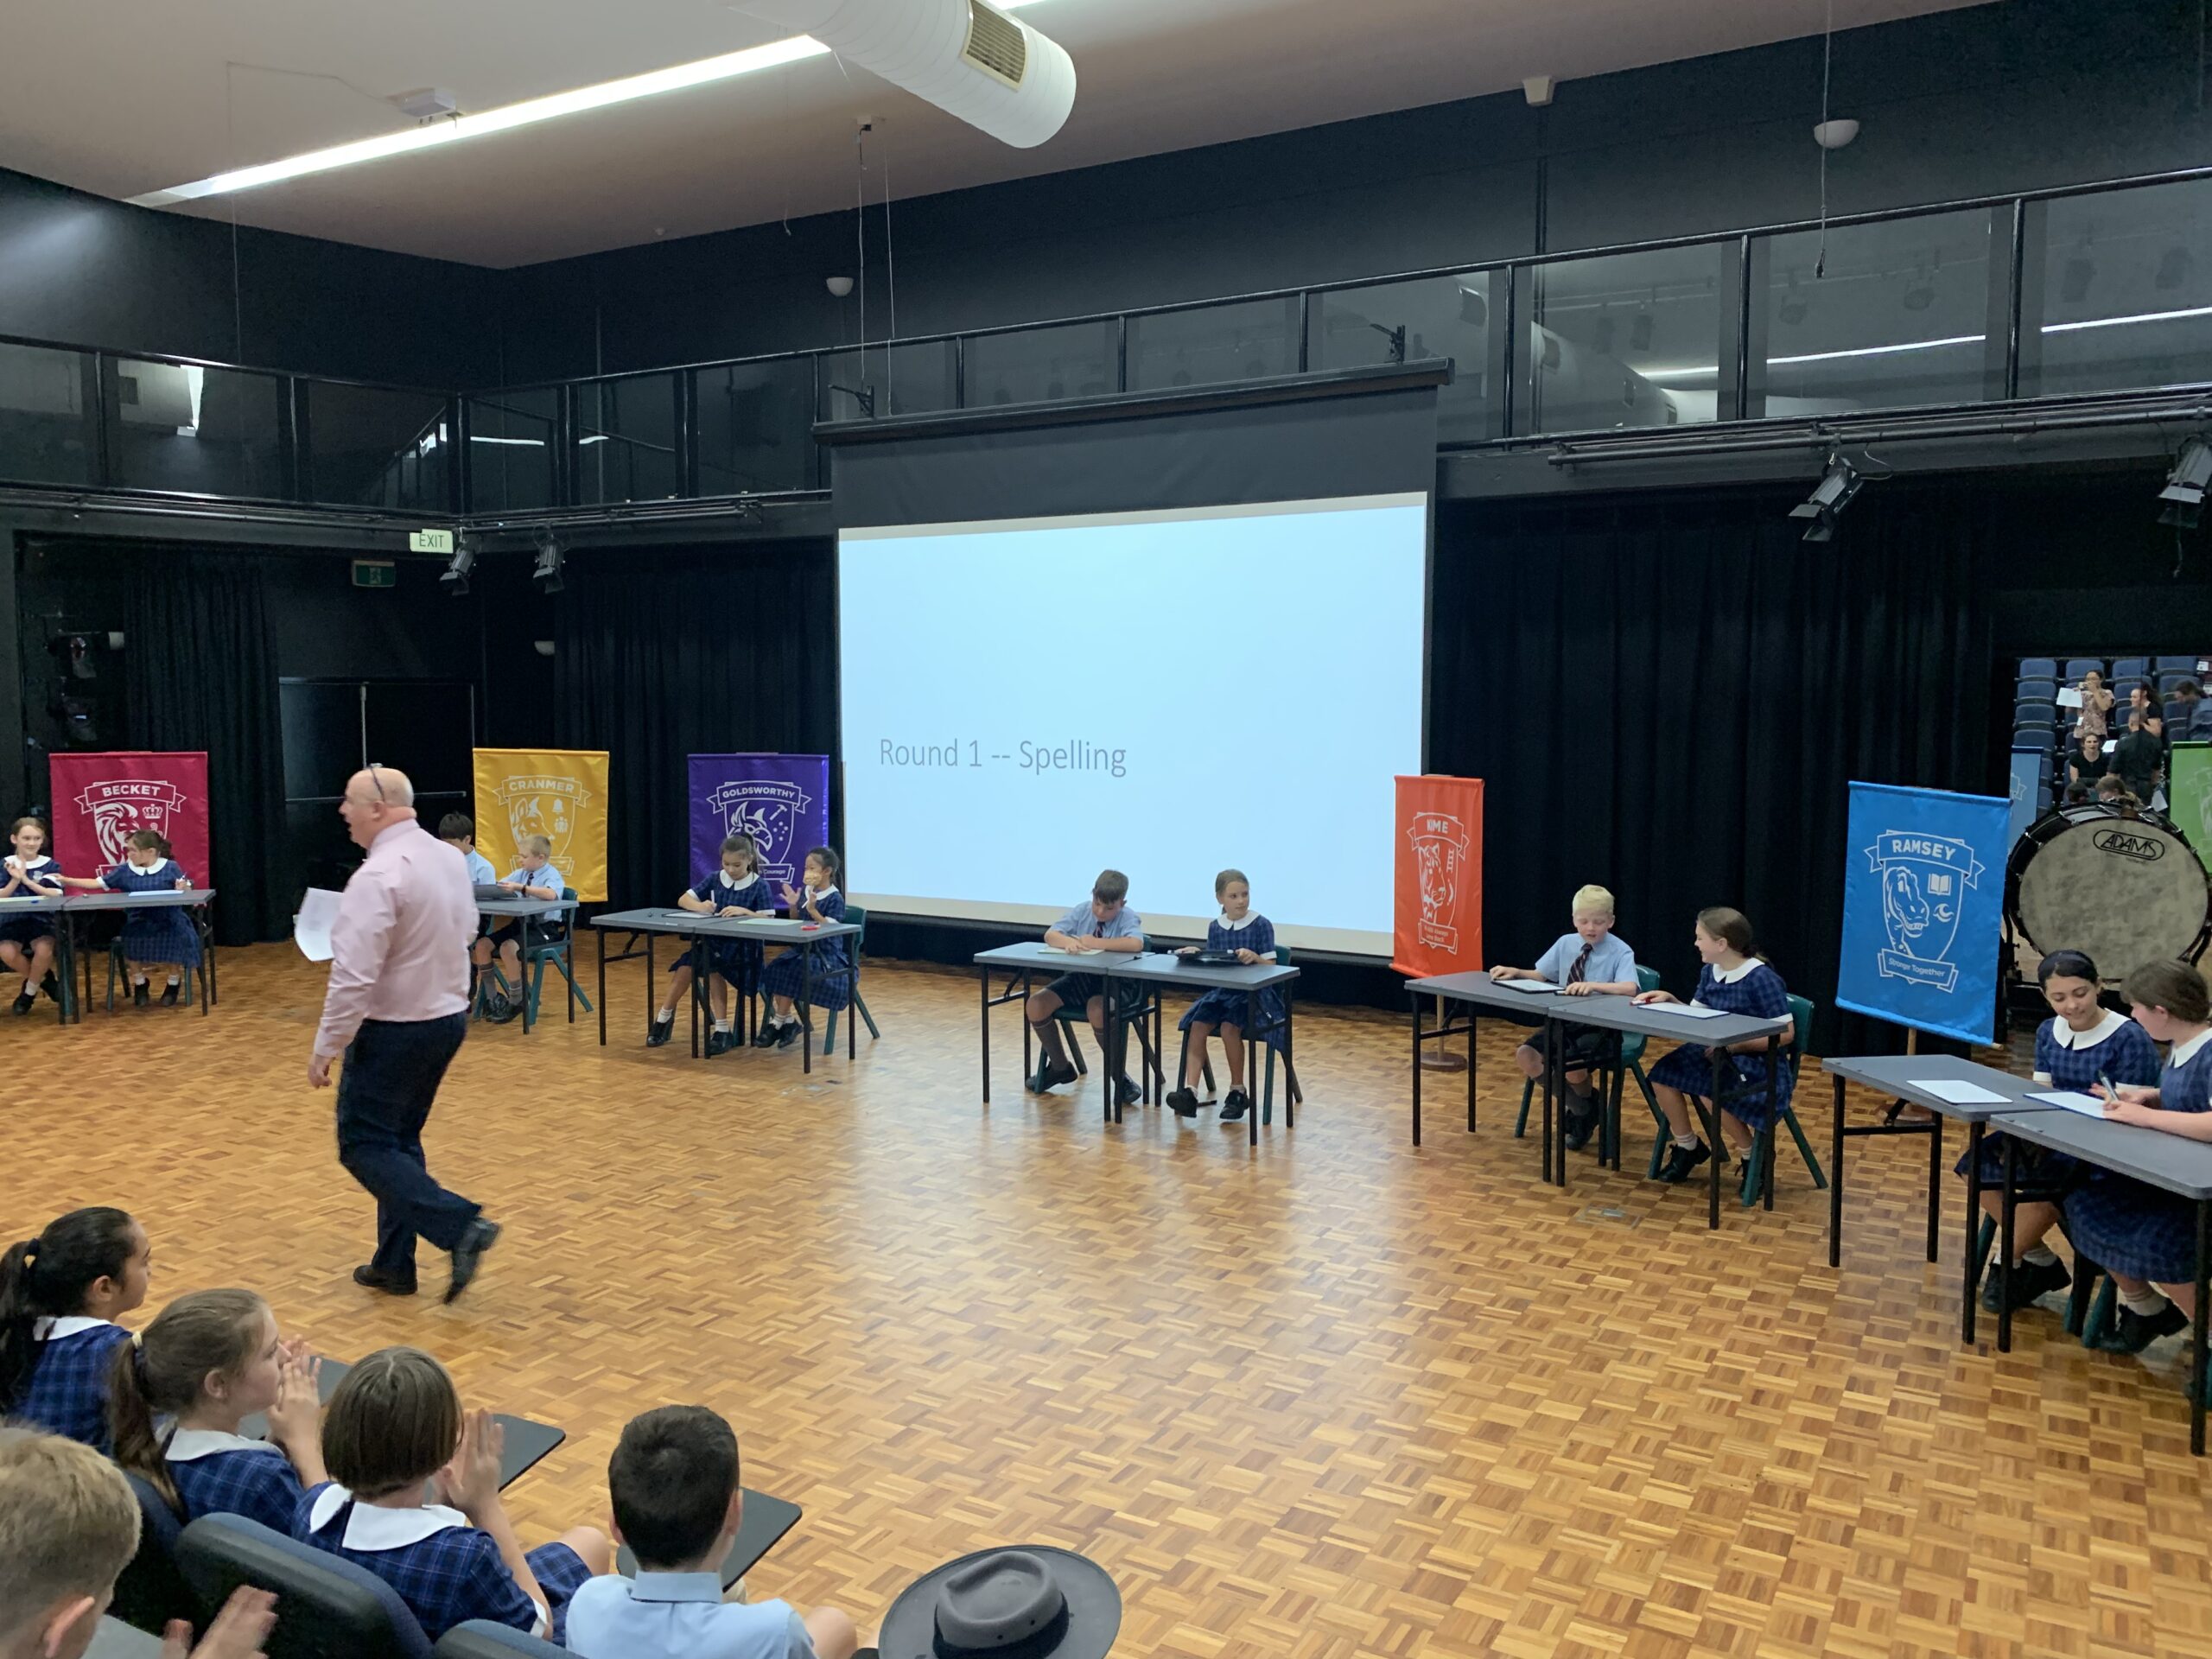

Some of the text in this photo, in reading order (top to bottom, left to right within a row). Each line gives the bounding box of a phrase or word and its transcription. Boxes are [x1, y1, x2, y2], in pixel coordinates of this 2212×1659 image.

[419, 533, 444, 548] EXIT
[880, 738, 958, 766] Round
[969, 739, 982, 767] 1
[1019, 739, 1127, 778] Spelling
[101, 784, 161, 798] BECKET
[509, 779, 575, 793] CRANMER
[722, 786, 795, 799] GOLDSWORTHY
[1891, 838, 1957, 861] RAMSEY
[2101, 833, 2157, 858] ADAMS
[1911, 963, 1946, 977] Together
